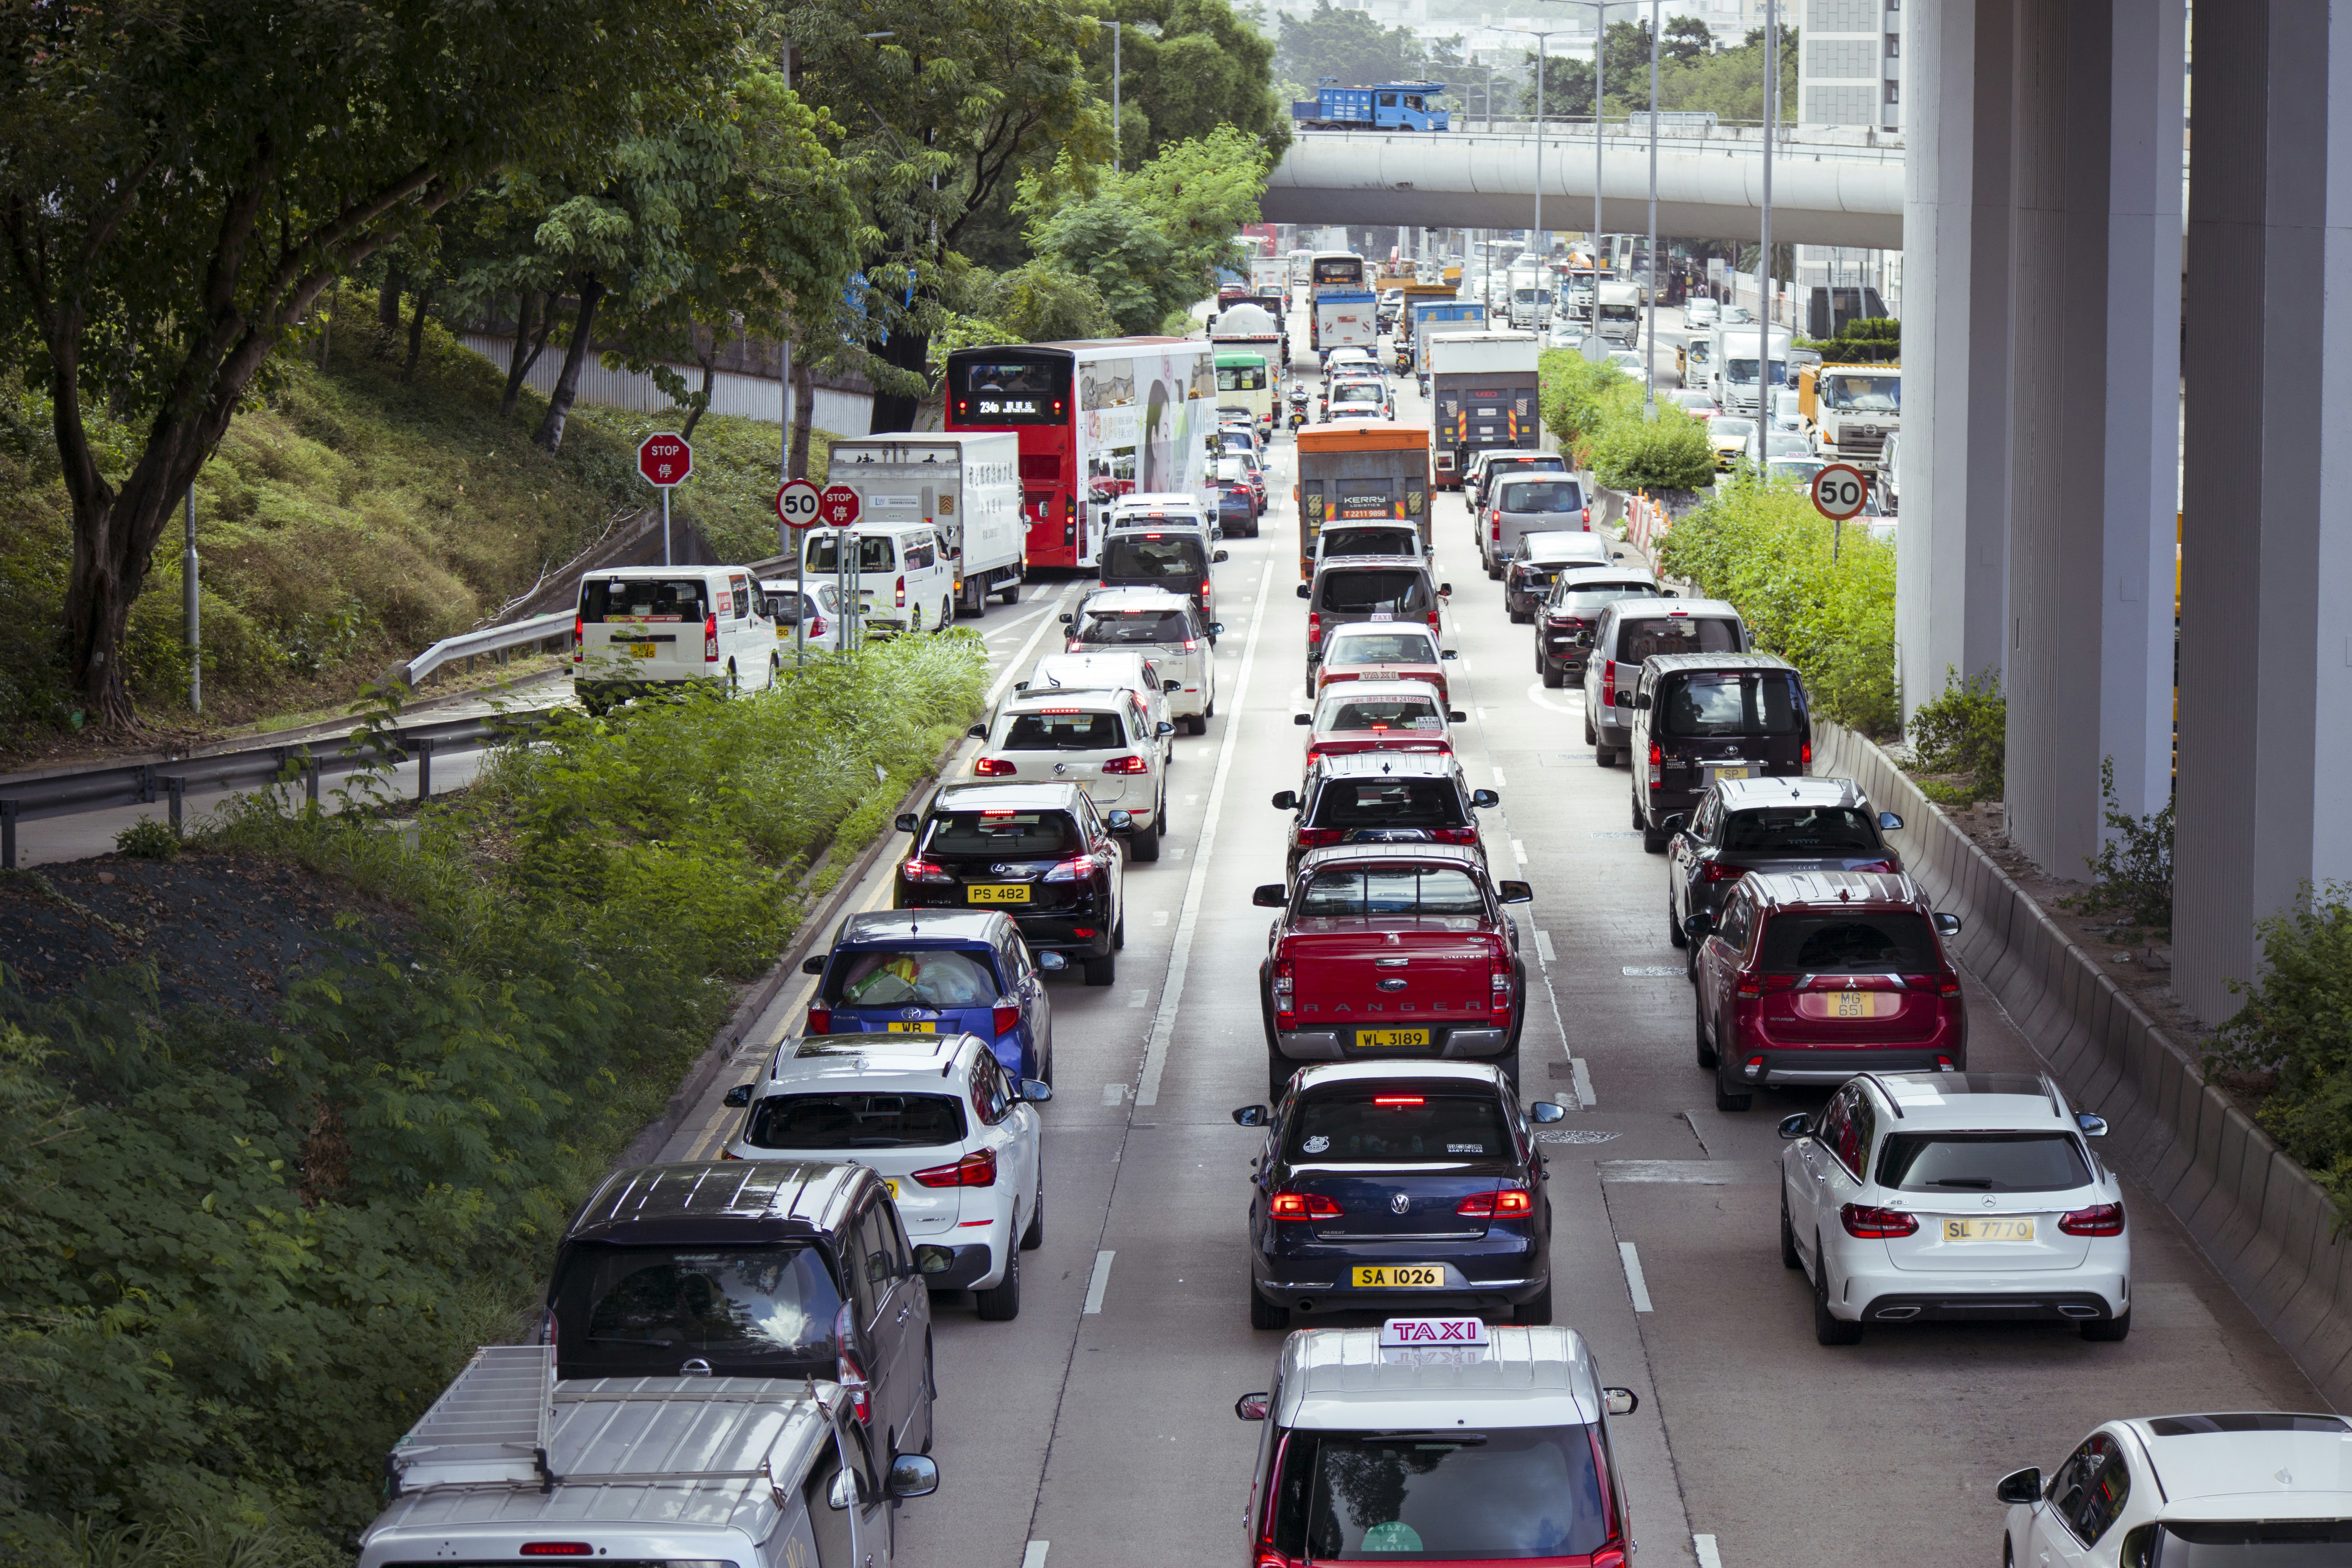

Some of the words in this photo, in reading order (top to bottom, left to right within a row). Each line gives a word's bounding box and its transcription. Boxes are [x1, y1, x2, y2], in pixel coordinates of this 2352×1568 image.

[980, 401, 999, 413] 234D
[652, 446, 679, 456] STOP
[658, 464, 671, 478] 停
[827, 494, 852, 502] STOP
[1821, 481, 1859, 505] 50
[785, 495, 815, 514] 50
[832, 506, 847, 521] 停
[974, 889, 991, 899] PS
[998, 889, 1024, 899] 482
[1841, 993, 1860, 1004] MG
[1303, 1001, 1481, 1012] RANGER
[1838, 1005, 1863, 1016] 651
[1363, 1033, 1383, 1046] WL
[1389, 1033, 1423, 1044] 3189
[1949, 1222, 1971, 1237] SL
[1980, 1221, 2027, 1236] 7770
[1362, 1270, 1388, 1284] SA
[1394, 1269, 1435, 1284] 1026
[1393, 1322, 1475, 1341] TAXI
[1379, 1524, 1406, 1533] TAXI
[1387, 1533, 1397, 1544] 4
